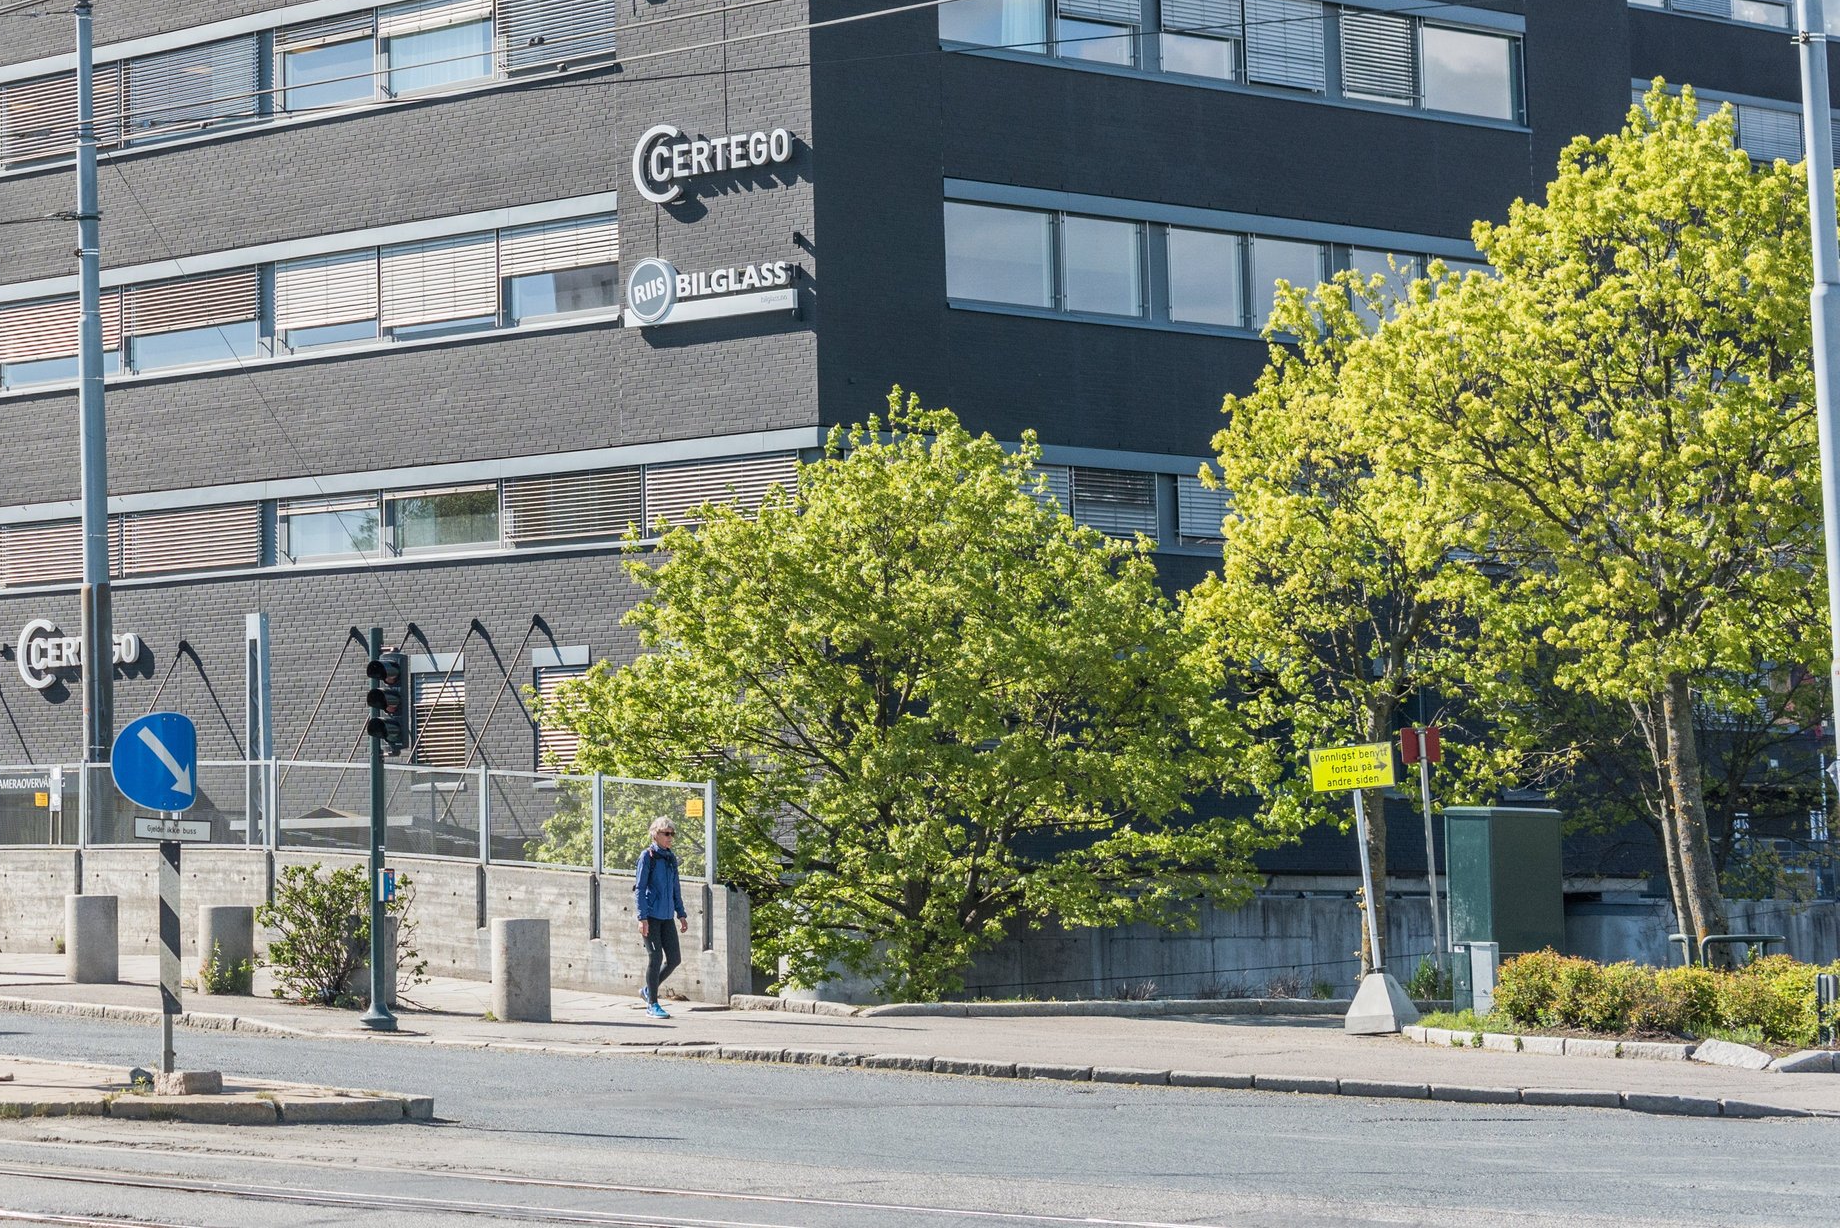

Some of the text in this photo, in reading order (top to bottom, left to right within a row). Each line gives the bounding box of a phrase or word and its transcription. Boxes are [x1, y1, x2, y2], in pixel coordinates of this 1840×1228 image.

[675, 260, 788, 298] BILGLASS
[633, 276, 666, 305] RIIS
[1313, 748, 1388, 763] Vennligst benytt
[1331, 763, 1358, 774] fortau
[1327, 775, 1380, 787] andre siden
[166, 825, 181, 835] ikke
[182, 827, 197, 835] buss
